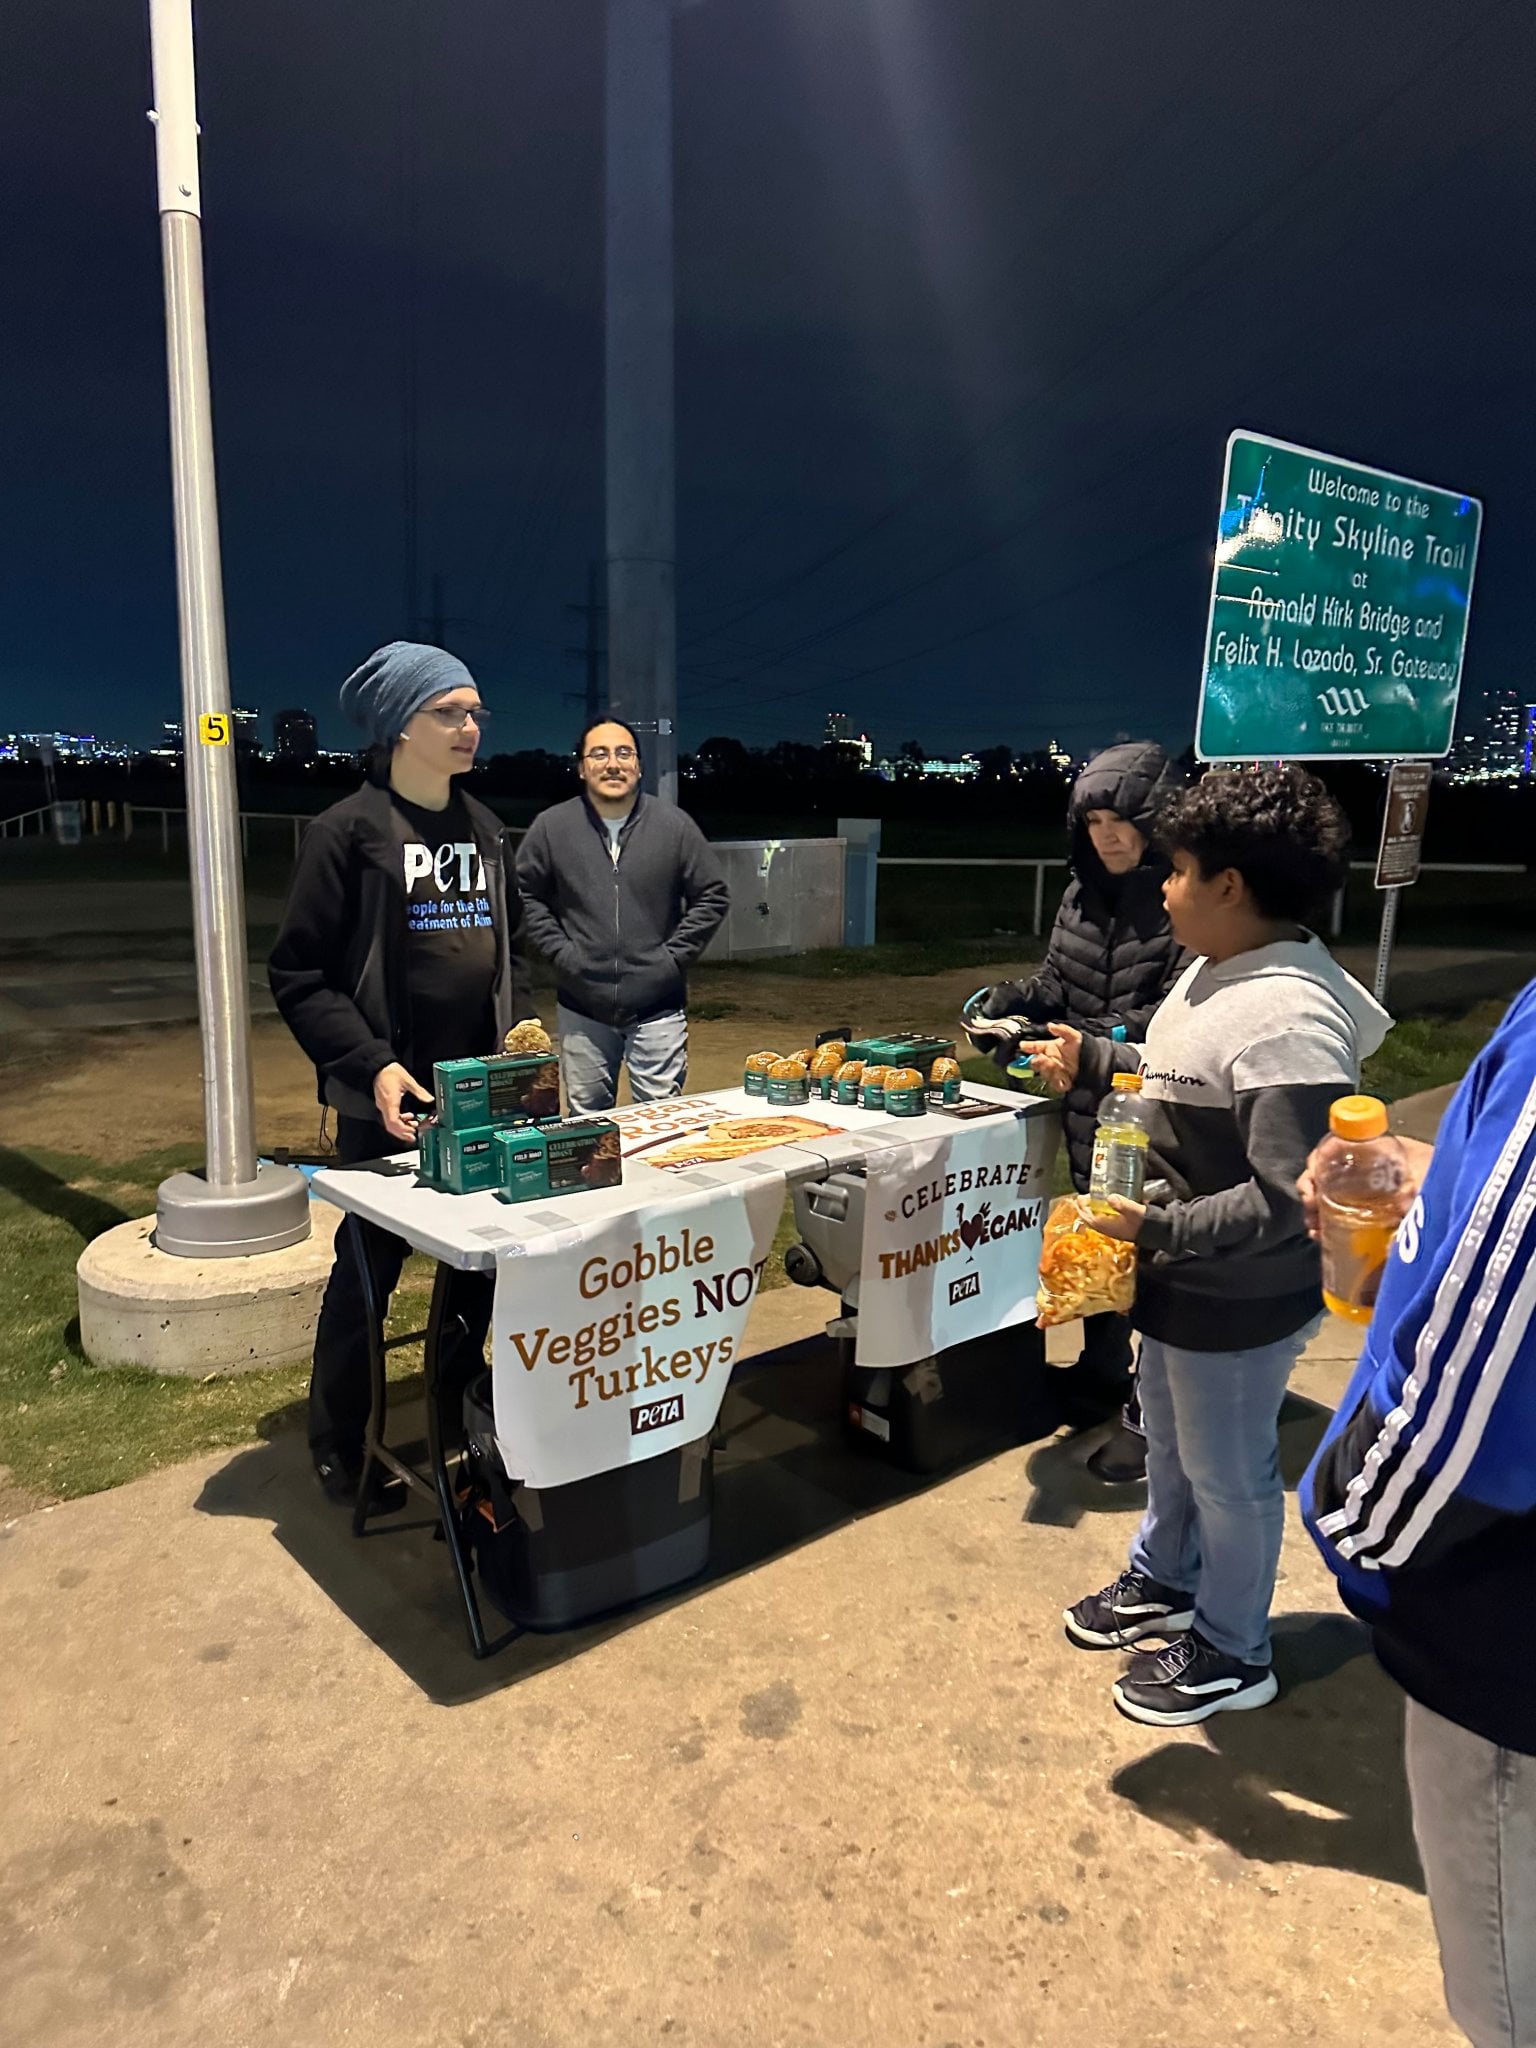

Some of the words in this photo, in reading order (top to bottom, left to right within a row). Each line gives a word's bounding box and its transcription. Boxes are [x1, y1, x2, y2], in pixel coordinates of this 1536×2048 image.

[1308, 468, 1380, 507] Welcome
[1385, 491, 1401, 512] to
[1406, 495, 1430, 519] the
[1332, 516, 1415, 561] Skyline
[1425, 535, 1467, 570] Trail
[1352, 572, 1368, 589] at
[1248, 586, 1318, 626] Ronald
[1321, 595, 1354, 628] Kirk
[1359, 601, 1411, 643] Bridge
[1415, 614, 1444, 640] and
[1214, 631, 1260, 666] Felix
[1266, 636, 1284, 668] H.
[1293, 638, 1358, 677] Lozada,
[1364, 646, 1384, 675] Sr.
[1391, 650, 1458, 688] Gateway
[207, 717, 225, 742] 5
[440, 899, 455, 914] for
[456, 899, 475, 913] the
[460, 914, 472, 928] of
[620, 1109, 742, 1140] Roast
[901, 1163, 1032, 1219] CELEBRATE
[579, 1229, 714, 1299] Gobble
[509, 1298, 681, 1372] Veggies
[692, 1257, 768, 1318] NOT
[569, 1335, 734, 1410] Turkeys
